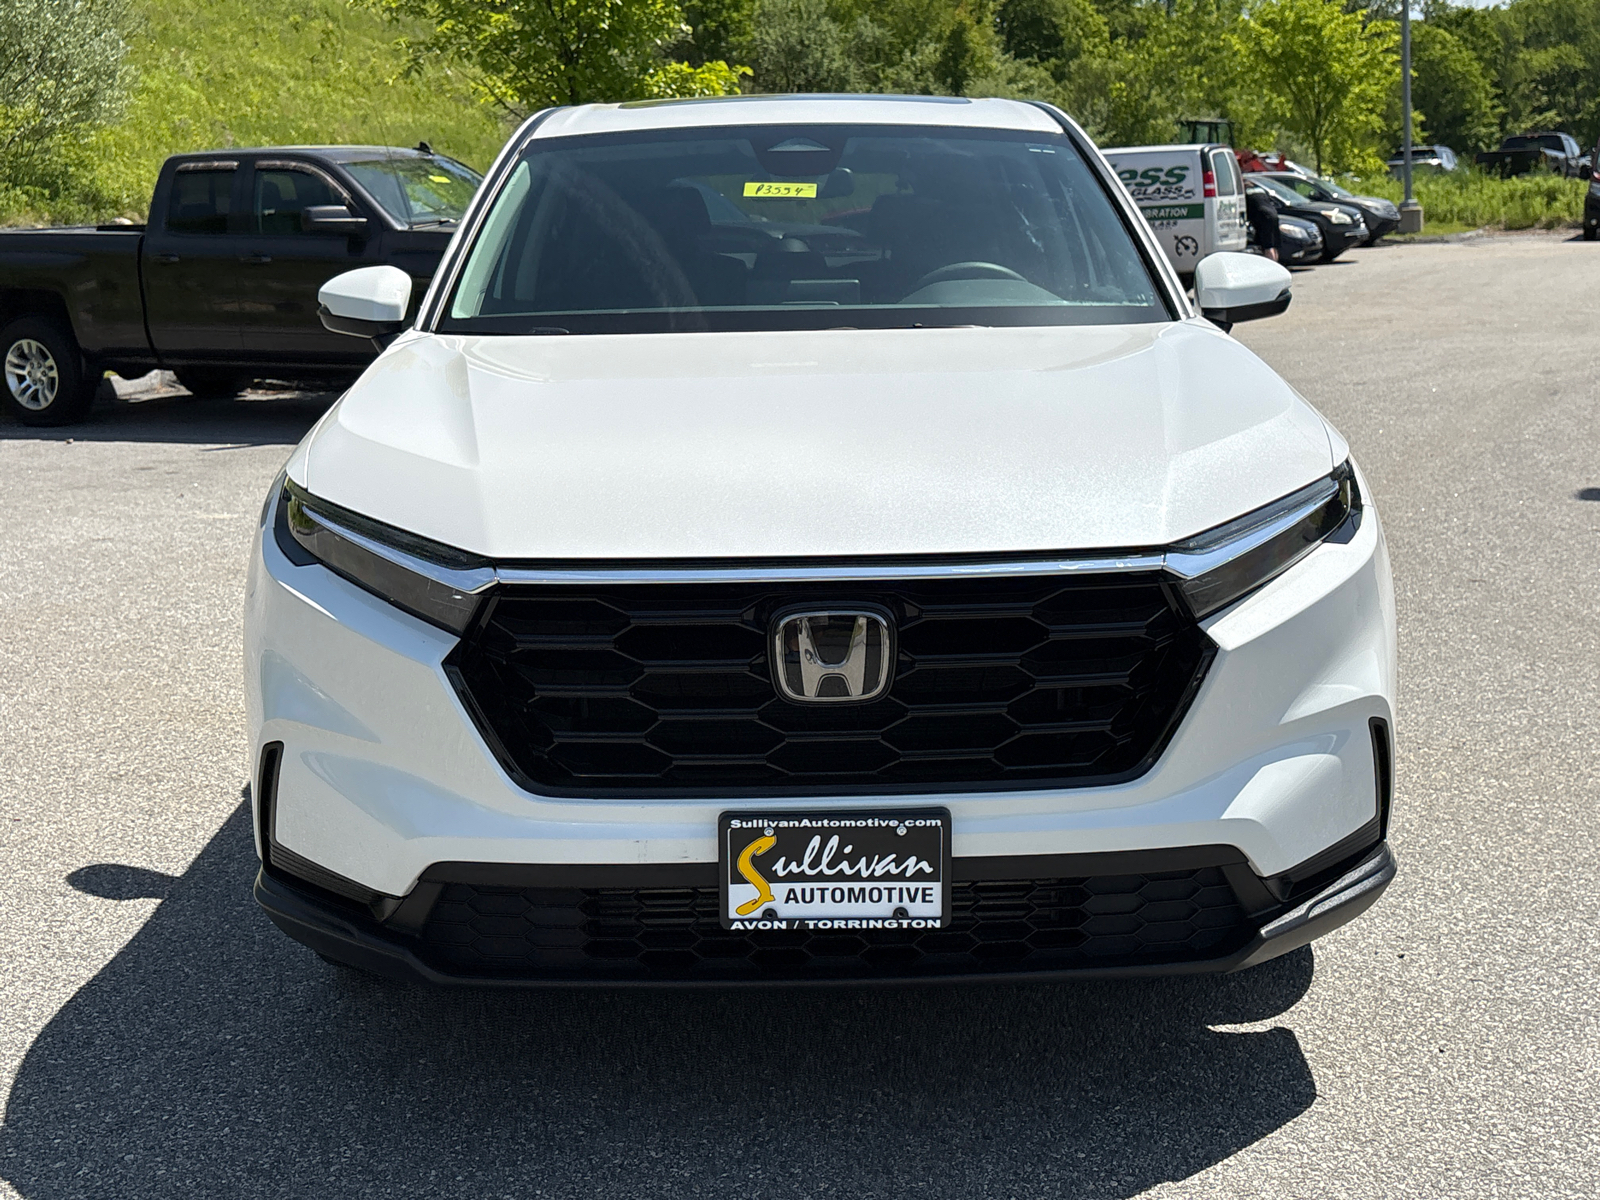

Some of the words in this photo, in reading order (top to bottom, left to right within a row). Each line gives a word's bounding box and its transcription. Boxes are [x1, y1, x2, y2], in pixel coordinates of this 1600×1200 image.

[1112, 164, 1189, 187] ess
[1131, 185, 1184, 196] GLASS
[730, 818, 942, 829] SullivanAutomotive.com
[735, 835, 934, 916] Sullivan
[784, 887, 934, 904] AUTOMOTIVE
[730, 920, 787, 931] AVON
[793, 920, 799, 930] /
[804, 919, 942, 930] TORRINGTON
